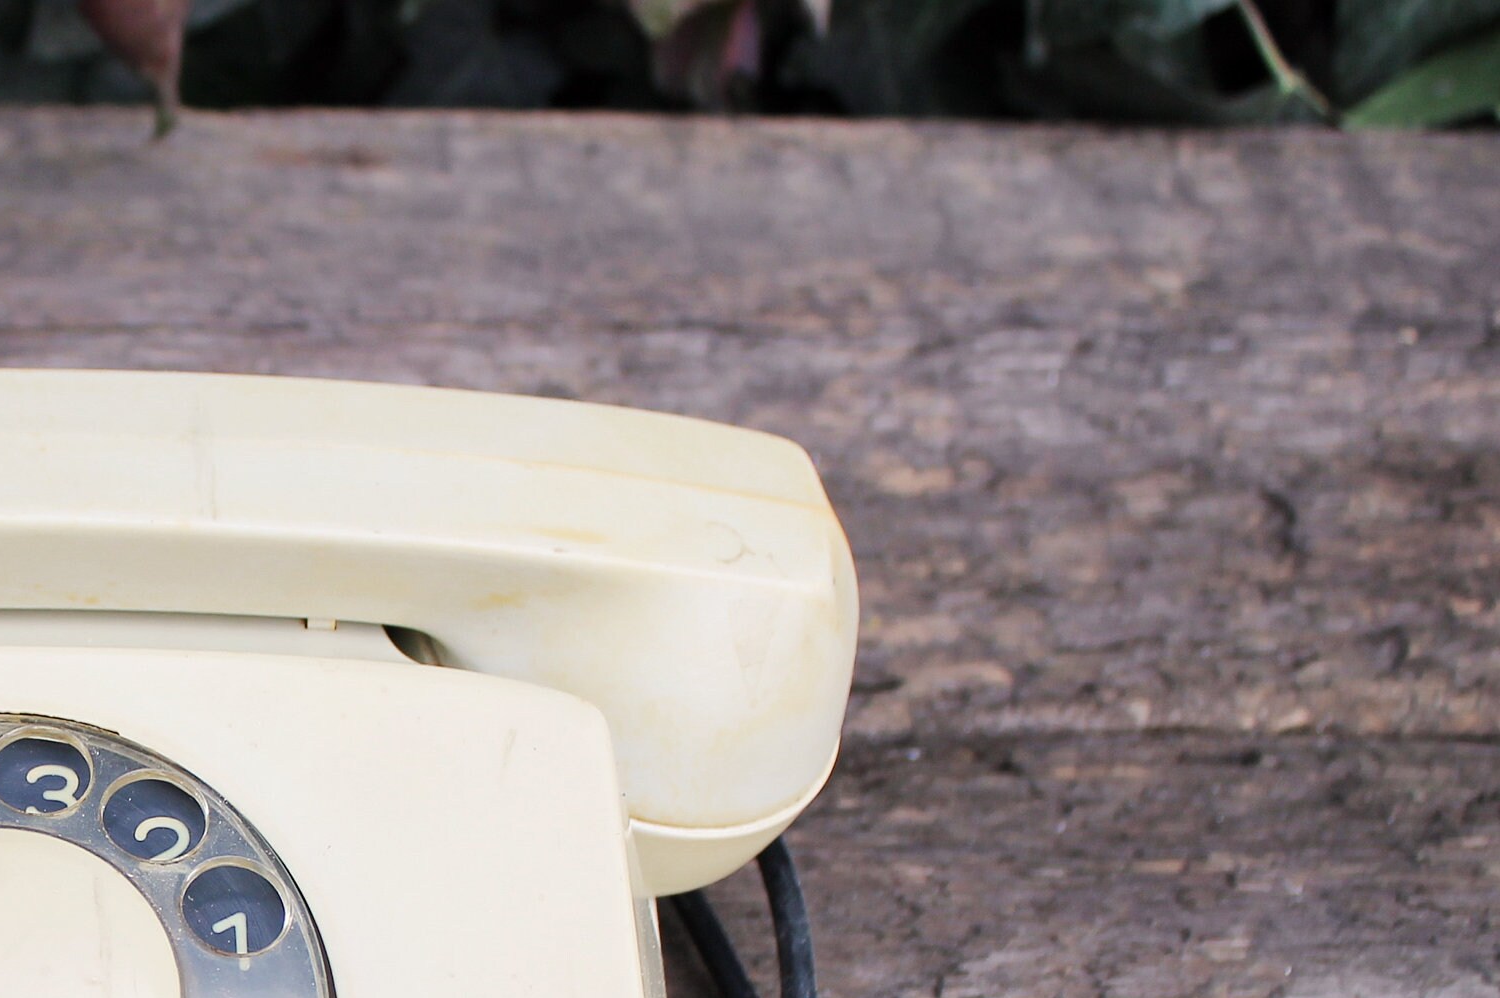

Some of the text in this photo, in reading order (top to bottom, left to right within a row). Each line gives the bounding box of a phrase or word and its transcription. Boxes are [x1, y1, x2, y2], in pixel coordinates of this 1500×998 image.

[26, 764, 80, 815] 3
[134, 816, 190, 862] 2
[212, 912, 248, 970] 1
